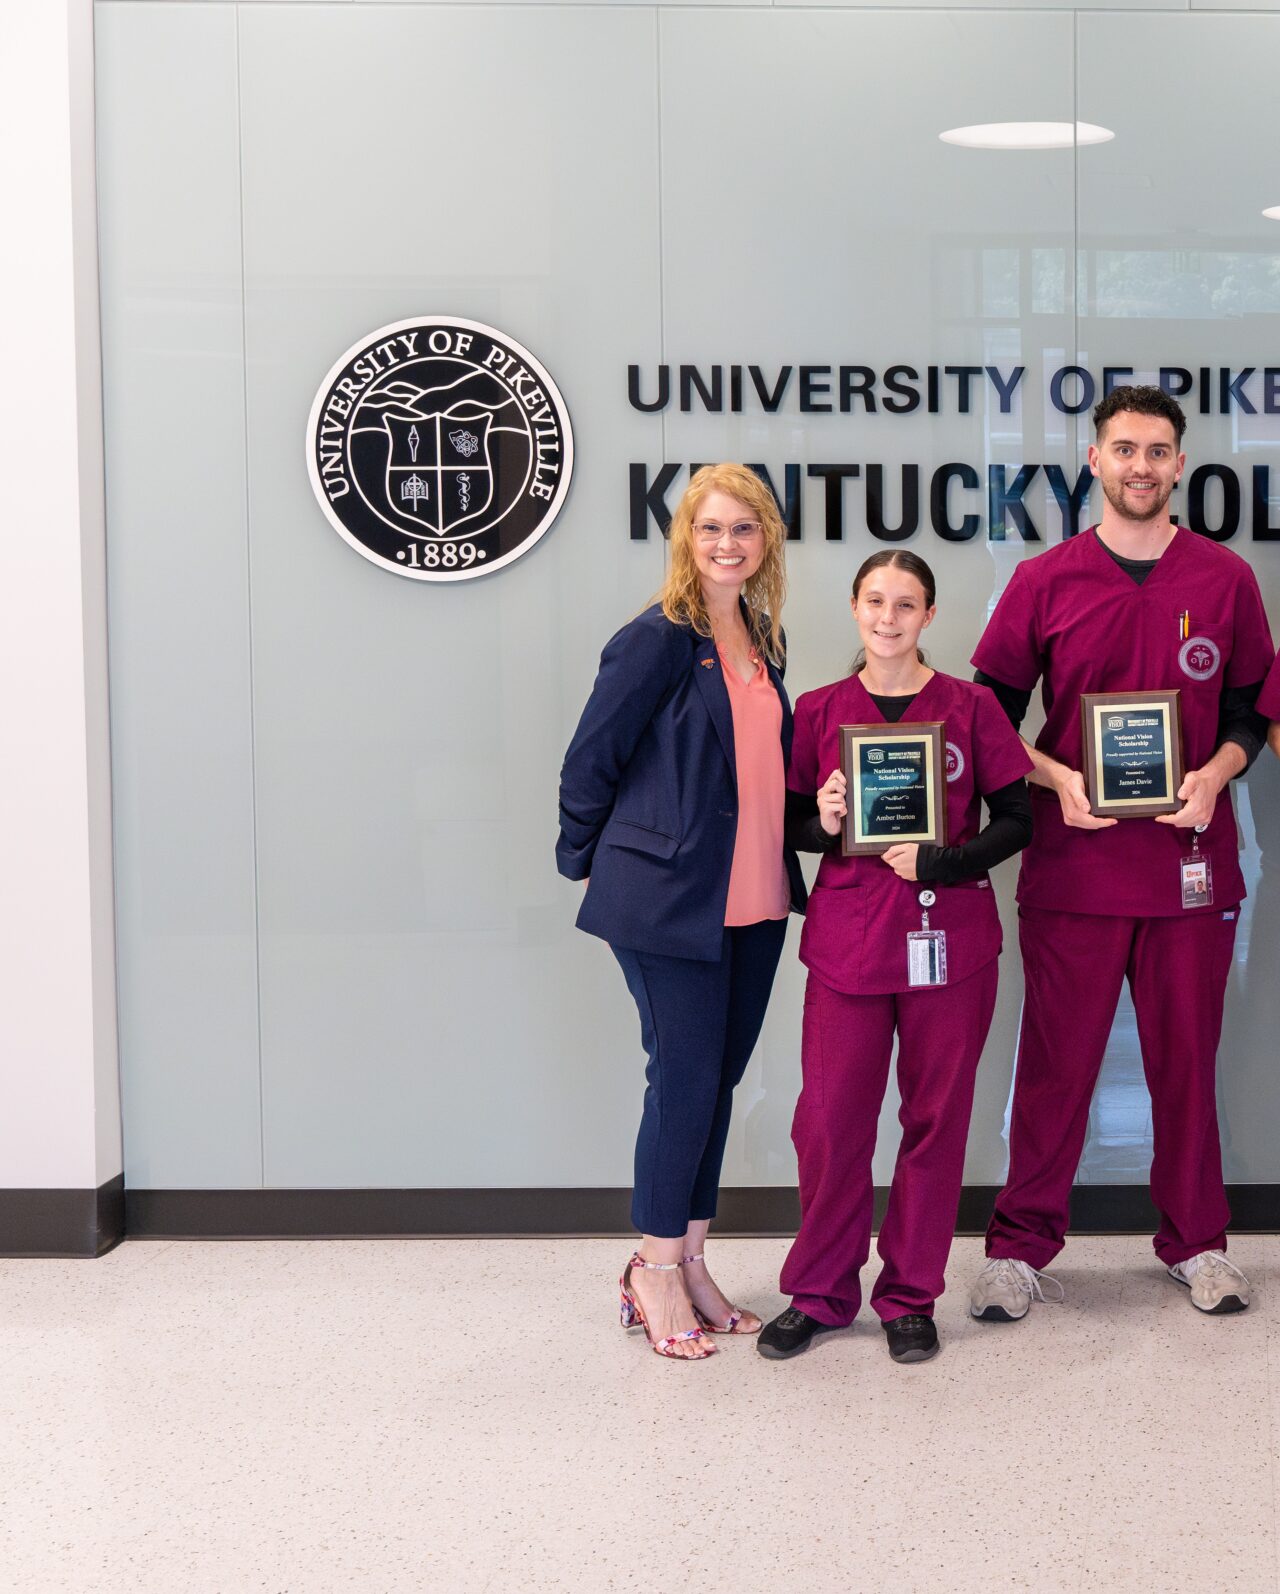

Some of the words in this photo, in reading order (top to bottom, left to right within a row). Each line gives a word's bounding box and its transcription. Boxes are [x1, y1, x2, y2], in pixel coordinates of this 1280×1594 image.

[319, 332, 419, 502] UNIVERSITY
[428, 330, 474, 357] OF
[481, 345, 560, 502] PIKEVILLE
[627, 364, 1026, 414] UNIVERSITY
[629, 463, 1094, 542] KNTUCKY
[407, 543, 478, 567] 1889
